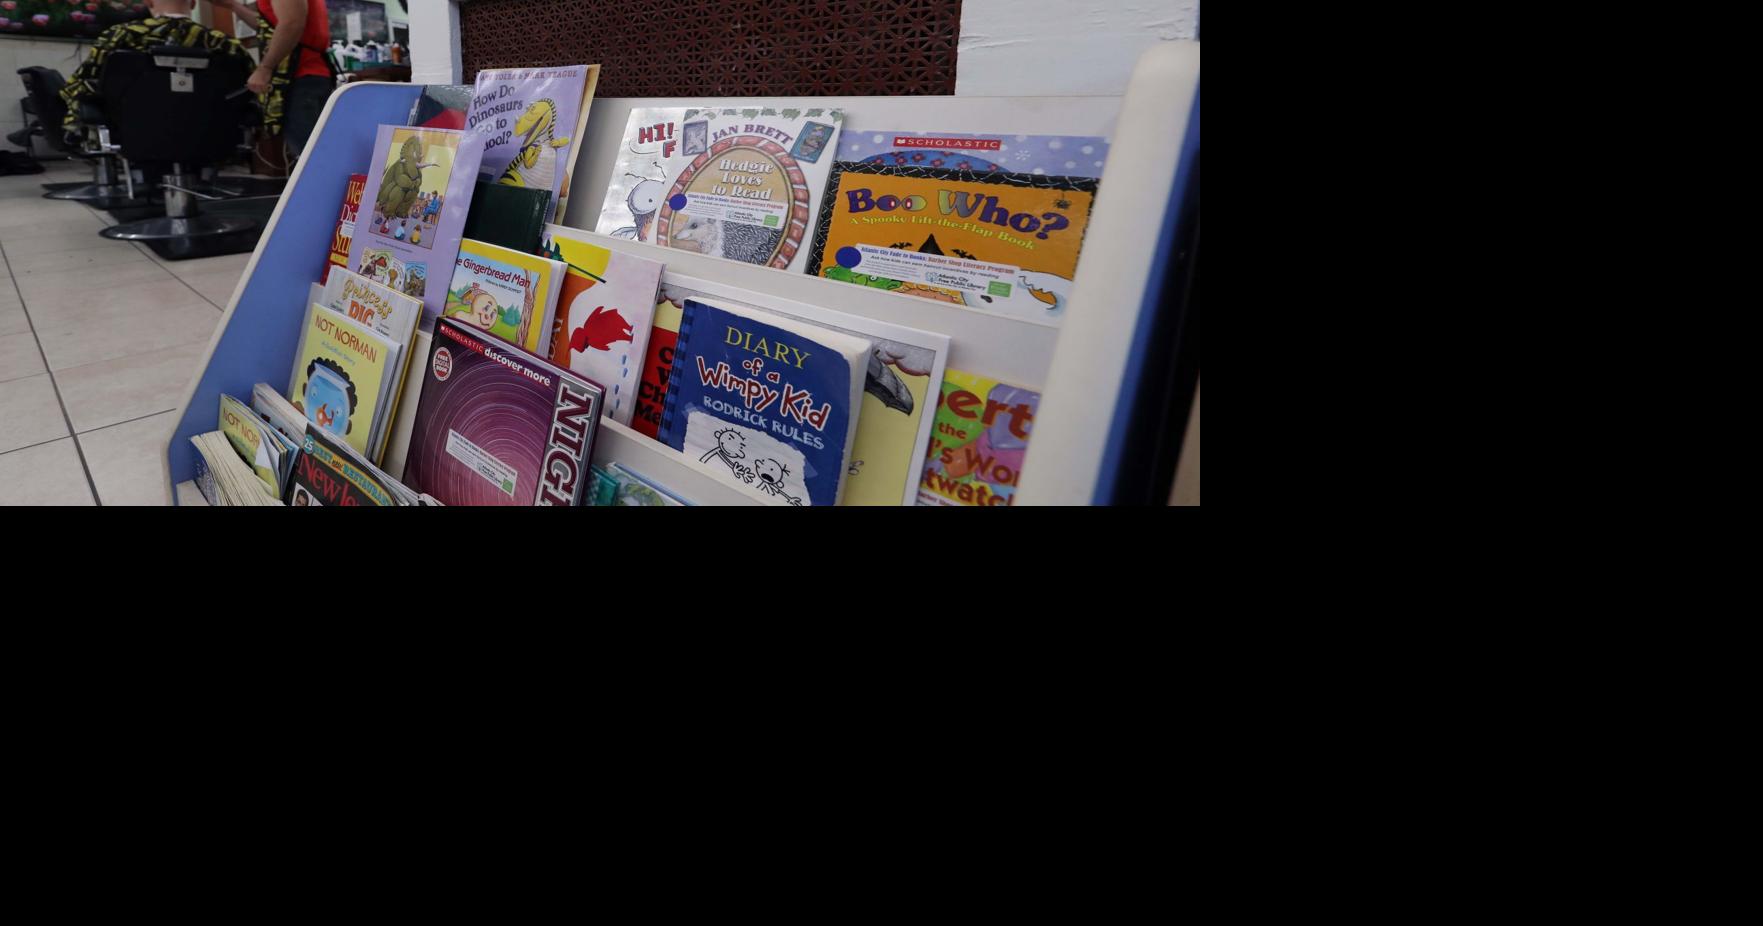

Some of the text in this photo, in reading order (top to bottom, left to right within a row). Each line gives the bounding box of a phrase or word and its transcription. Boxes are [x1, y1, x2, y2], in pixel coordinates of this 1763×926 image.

[473, 84, 515, 111] How Do
[468, 100, 523, 129] Dinosaurs
[496, 118, 508, 130] to
[711, 124, 794, 145] JAN BRETT
[907, 137, 1000, 149] SCHOLASTIC
[719, 159, 776, 174] Hedgie
[721, 172, 763, 187] Loves
[730, 184, 773, 200] Read
[845, 188, 1071, 240] Boo Who?
[862, 215, 908, 225] Spooky
[911, 215, 993, 238] Lift-the-Flap
[997, 231, 1036, 251] Book
[463, 258, 513, 282] Gingerbread
[511, 273, 531, 289] Man
[315, 314, 335, 335] NOT
[335, 327, 378, 363] NORMAN
[724, 326, 812, 370] DIARY
[445, 327, 551, 386] SCHOLASTIC discover more
[743, 358, 781, 384] of a
[696, 356, 832, 432] Wimpy Kid
[223, 407, 240, 430] NOT
[241, 426, 260, 448] NOR
[703, 395, 825, 451] RODRICK RULES
[938, 421, 968, 440] the
[939, 389, 1034, 443] ert
[304, 438, 314, 452] 25
[297, 453, 341, 502] New
